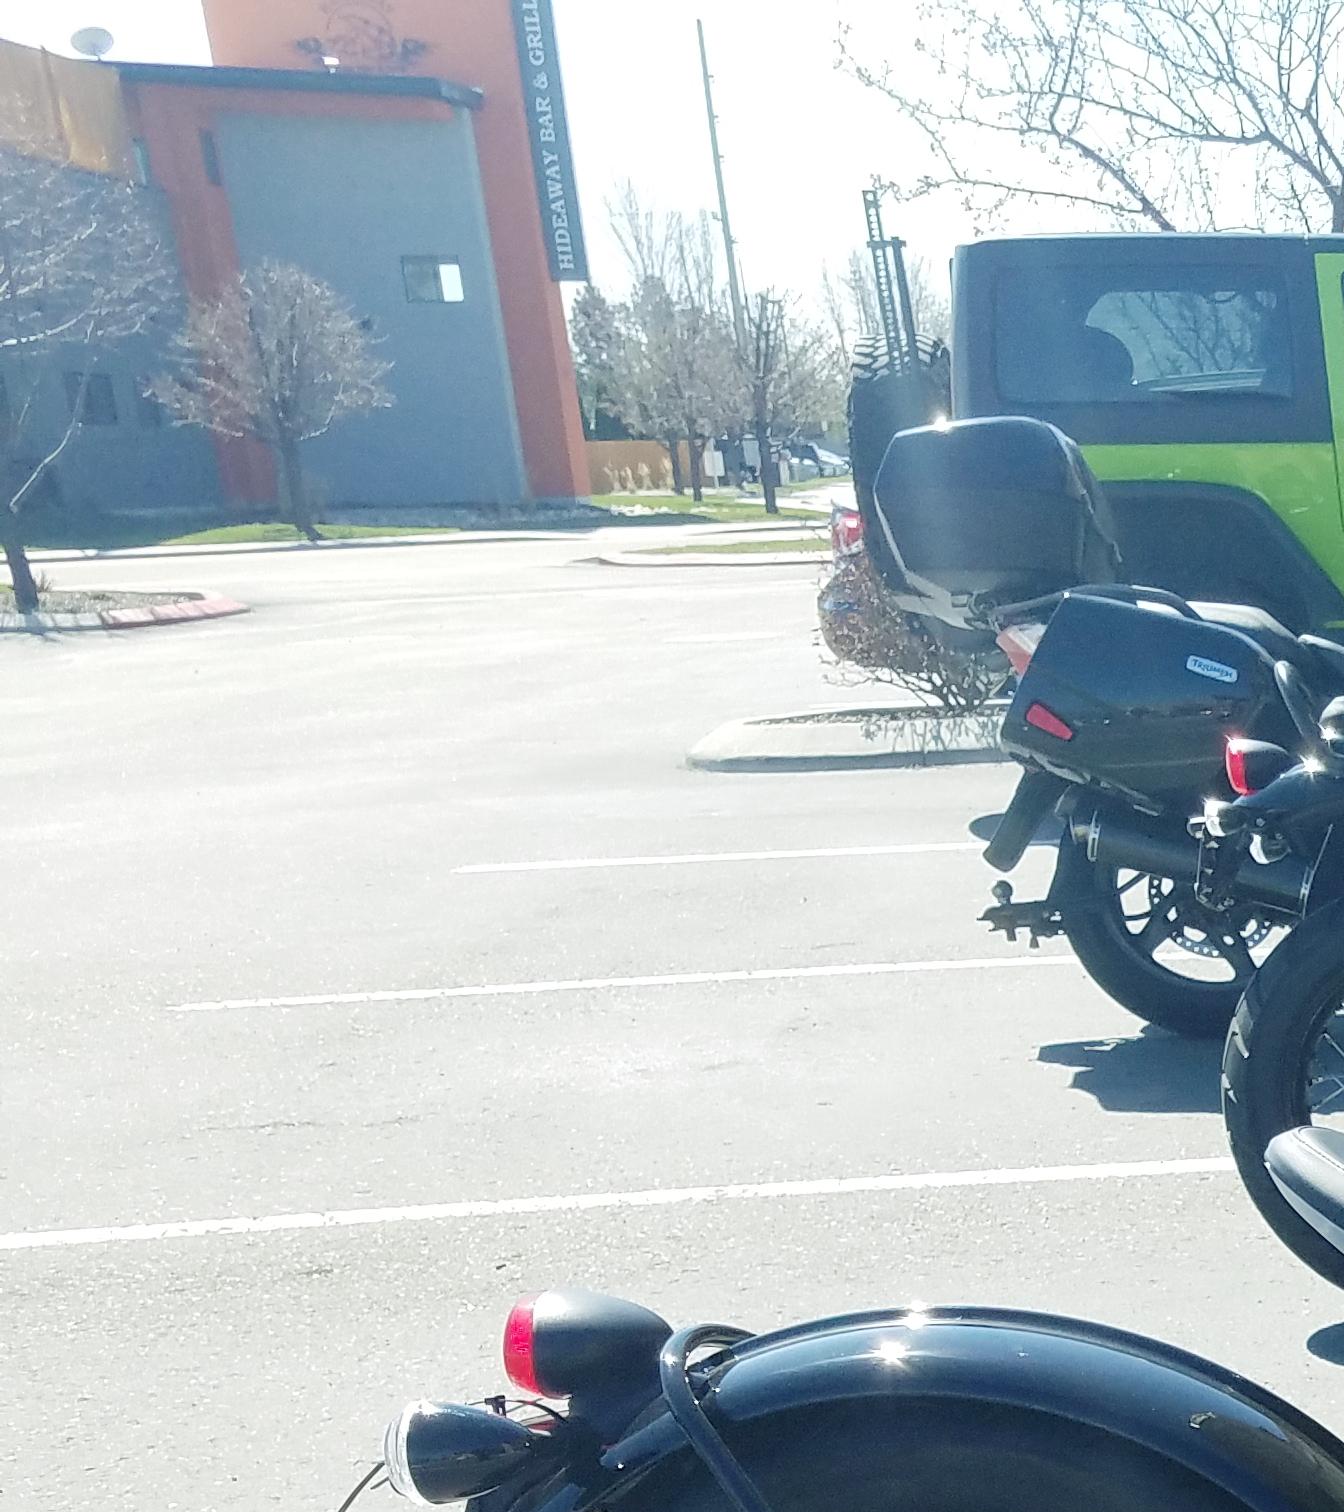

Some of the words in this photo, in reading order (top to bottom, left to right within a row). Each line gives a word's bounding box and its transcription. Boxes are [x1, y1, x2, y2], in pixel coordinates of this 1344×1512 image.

[532, 71, 549, 89] &
[535, 96, 556, 143] BAR
[541, 149, 575, 270] HIDEAWAY
